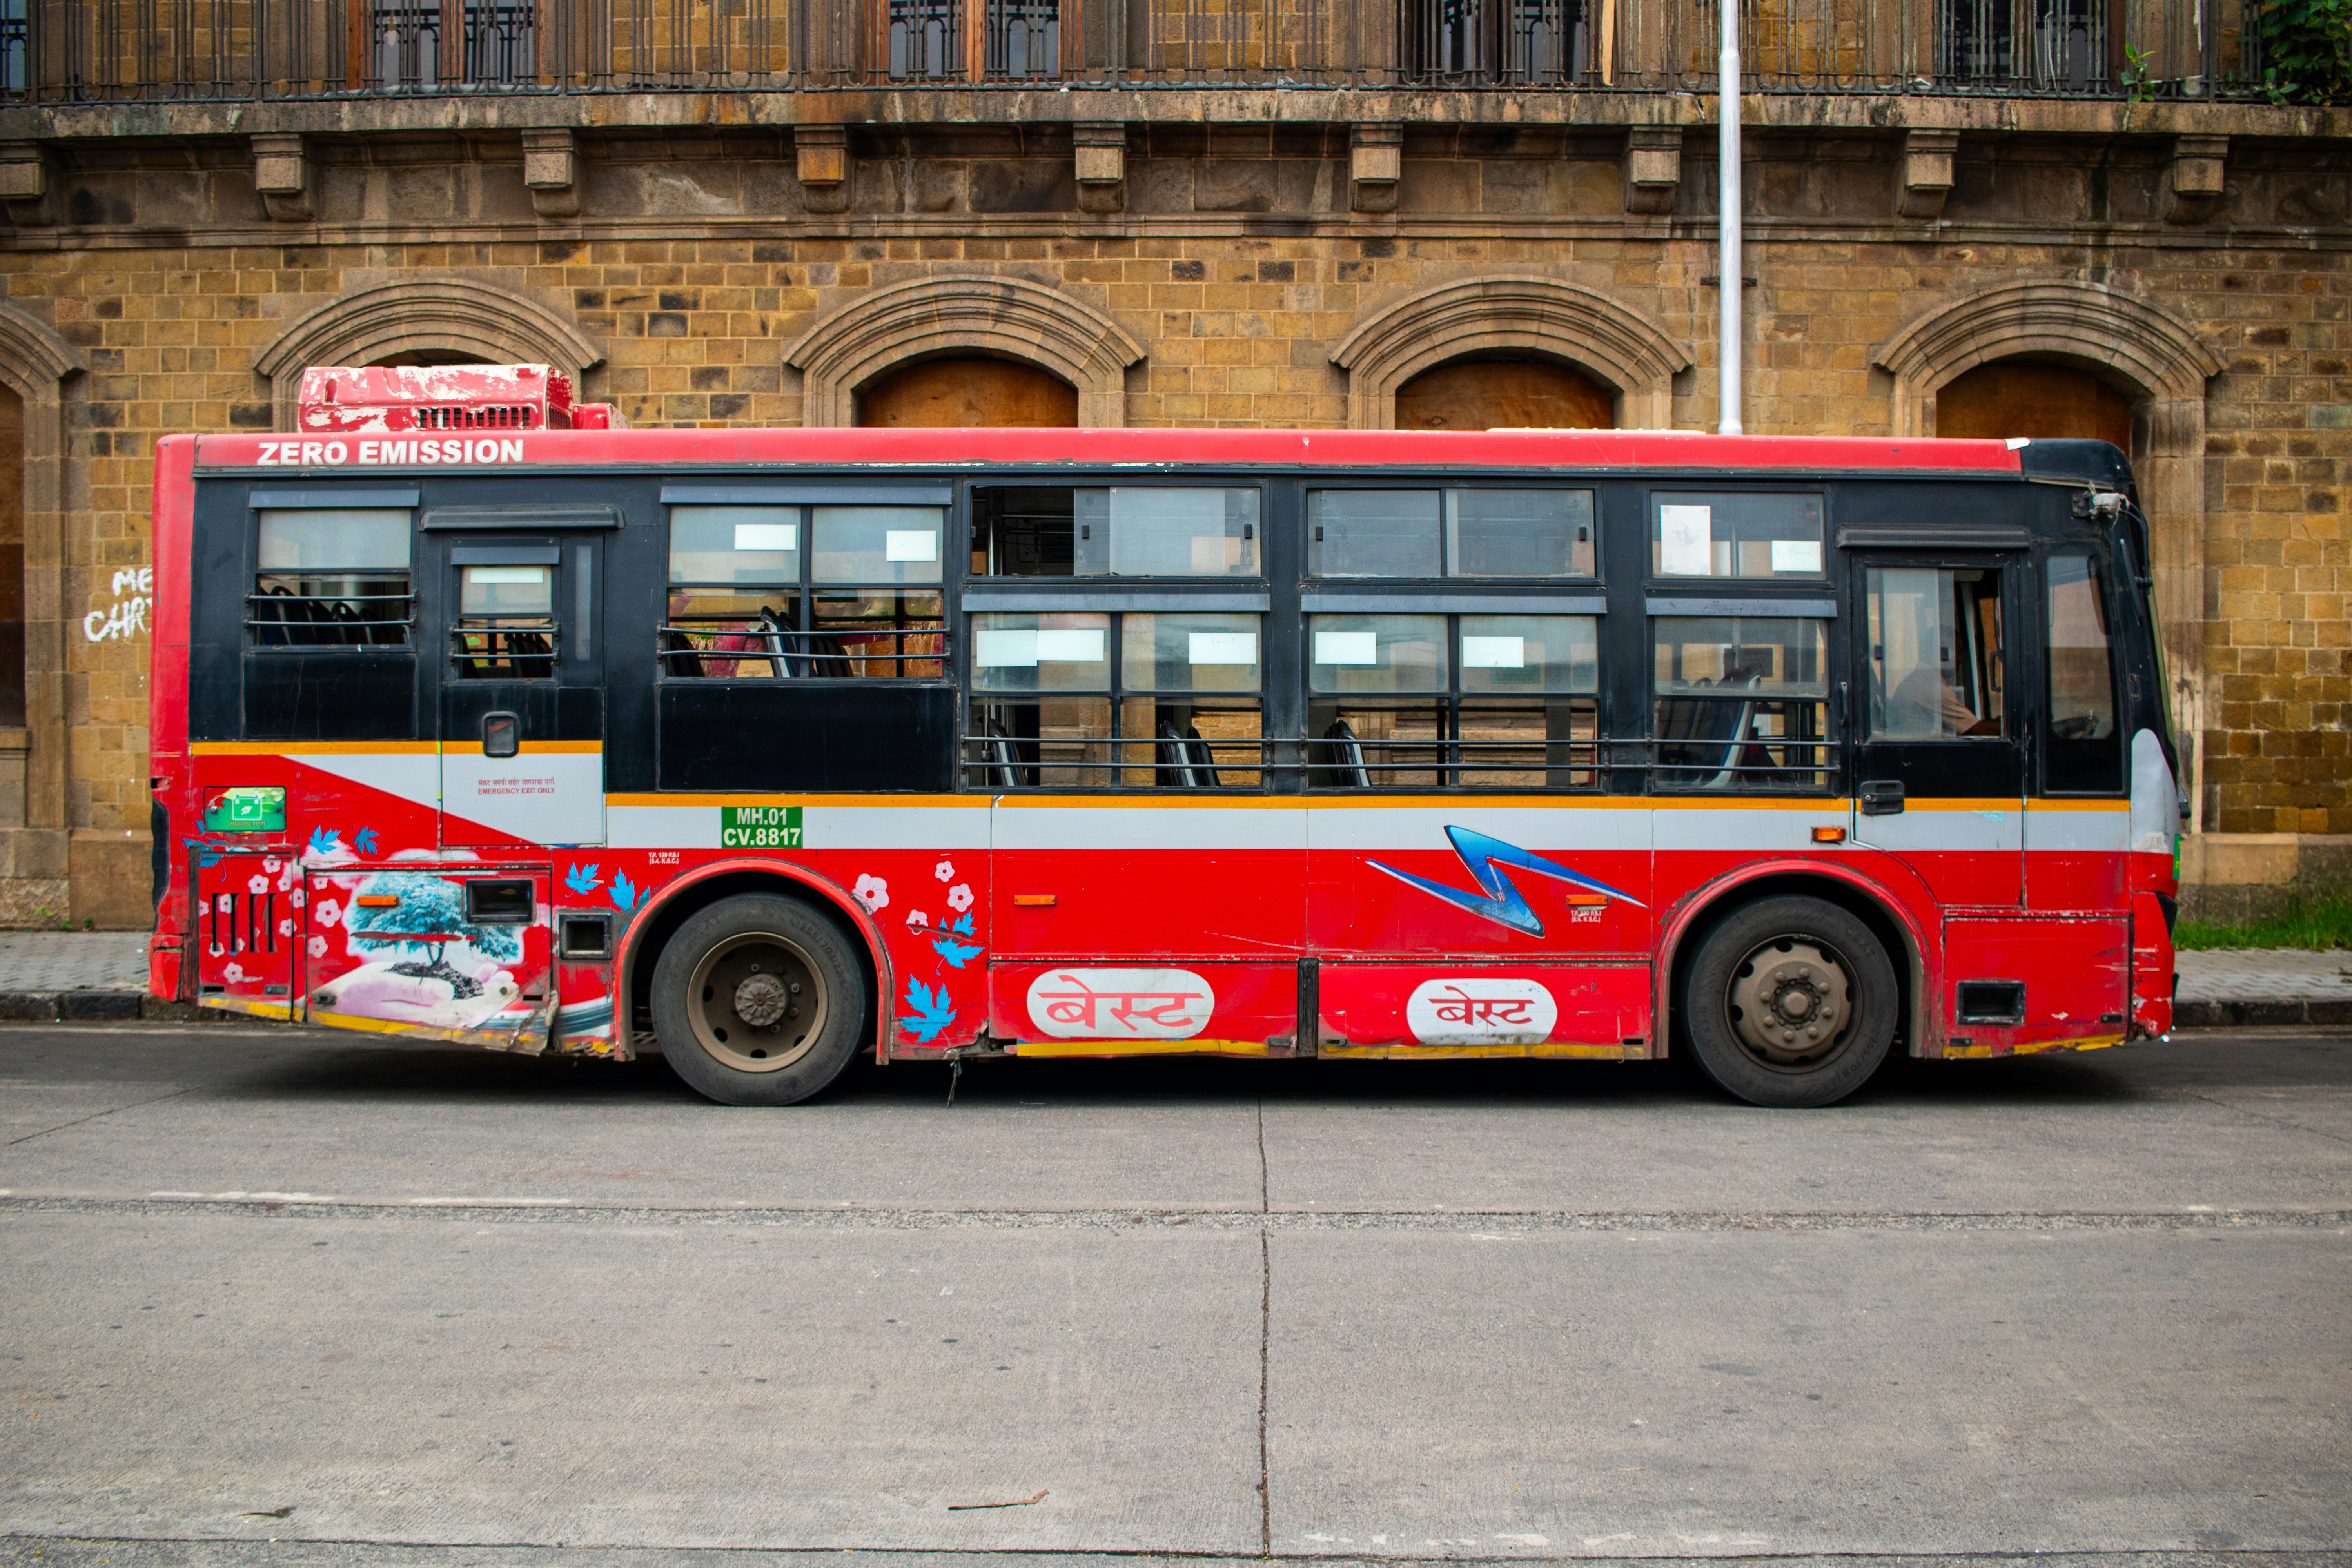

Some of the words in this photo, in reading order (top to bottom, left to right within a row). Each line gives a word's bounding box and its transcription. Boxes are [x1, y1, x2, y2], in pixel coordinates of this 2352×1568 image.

[257, 441, 347, 466] ZERO
[359, 439, 523, 465] EMISSION
[737, 808, 787, 825] MH.01
[723, 828, 801, 846] CV.8817
[1844, 926, 1875, 959] CEAT
[1037, 975, 1205, 1031] बेस्ट
[1428, 986, 1535, 1027] बेस्ट
